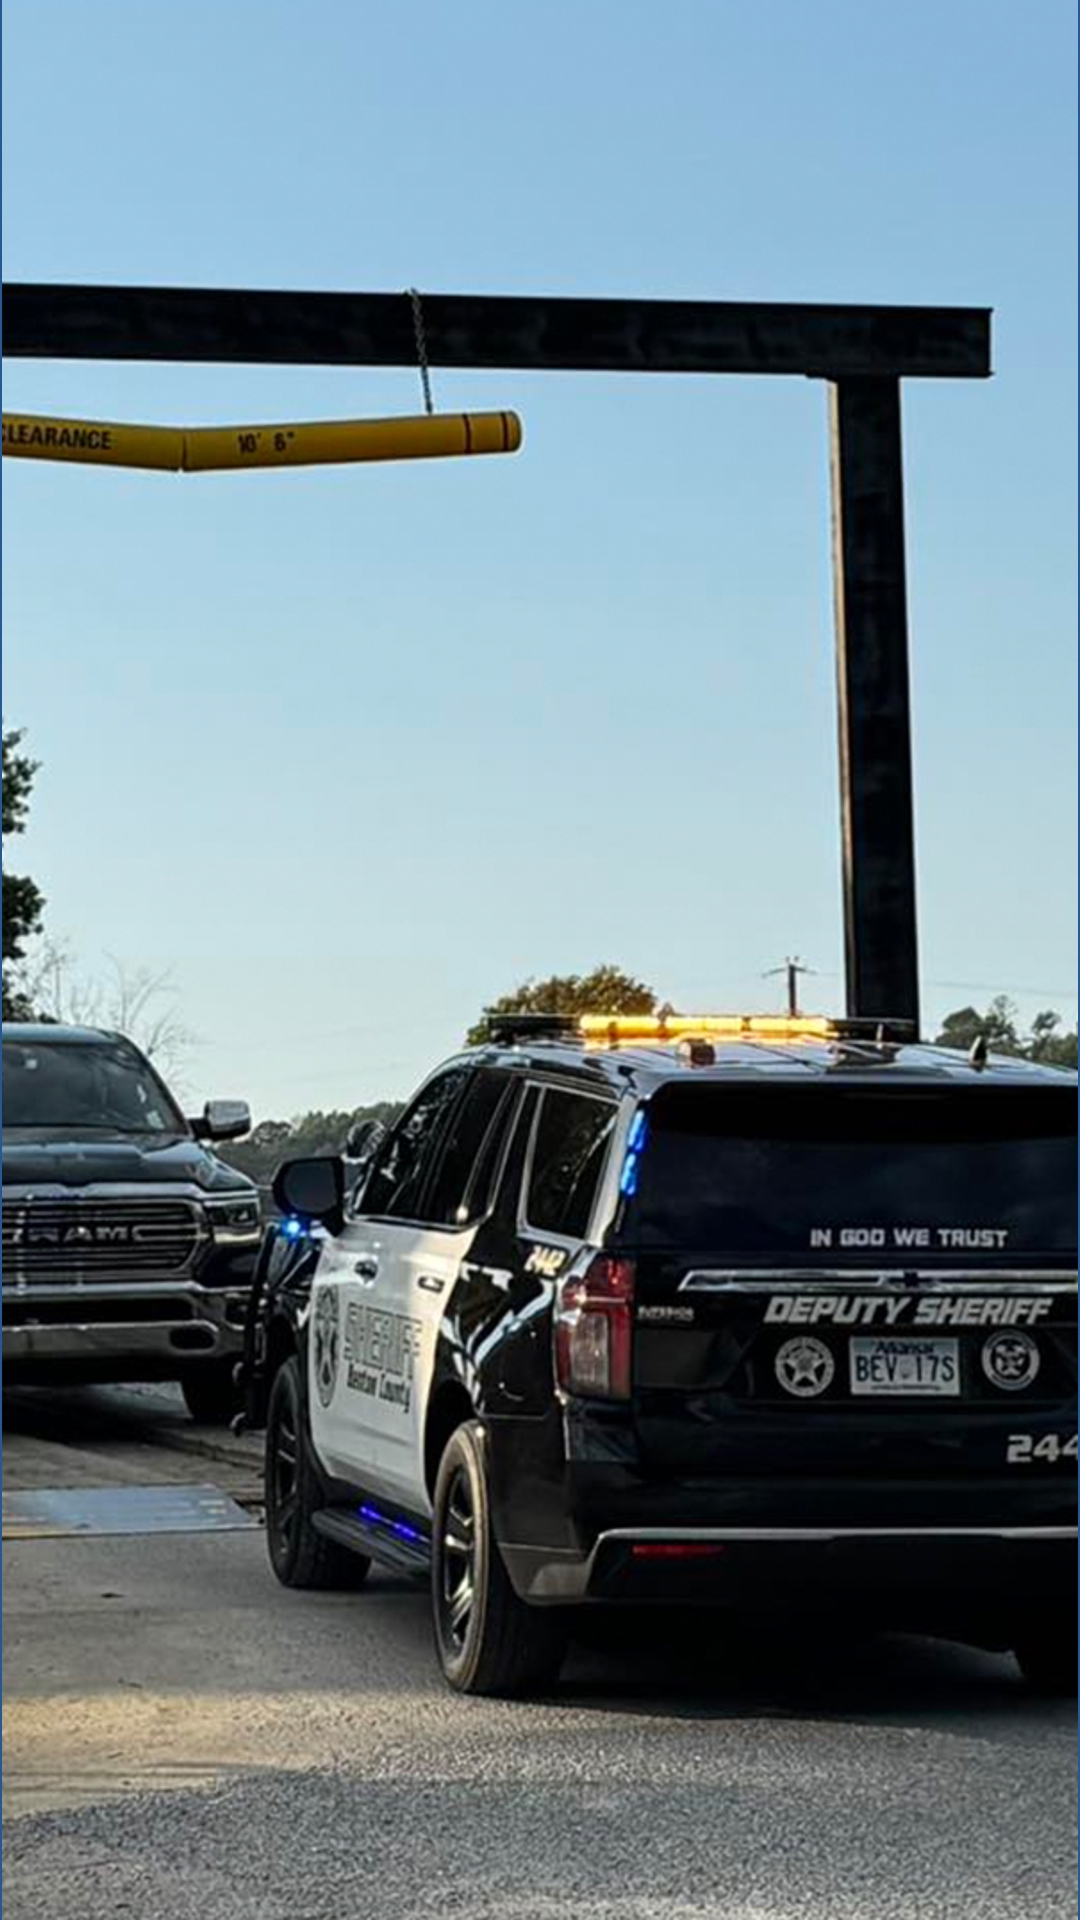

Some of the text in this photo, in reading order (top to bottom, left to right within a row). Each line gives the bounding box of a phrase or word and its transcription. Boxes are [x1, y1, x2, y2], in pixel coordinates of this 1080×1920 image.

[810, 1228, 1008, 1248] IN GOD WE TRUST
[763, 1296, 1053, 1325] DEPUTY SHERIFF
[855, 1355, 897, 1382] BEV
[379, 1373, 411, 1414] County
